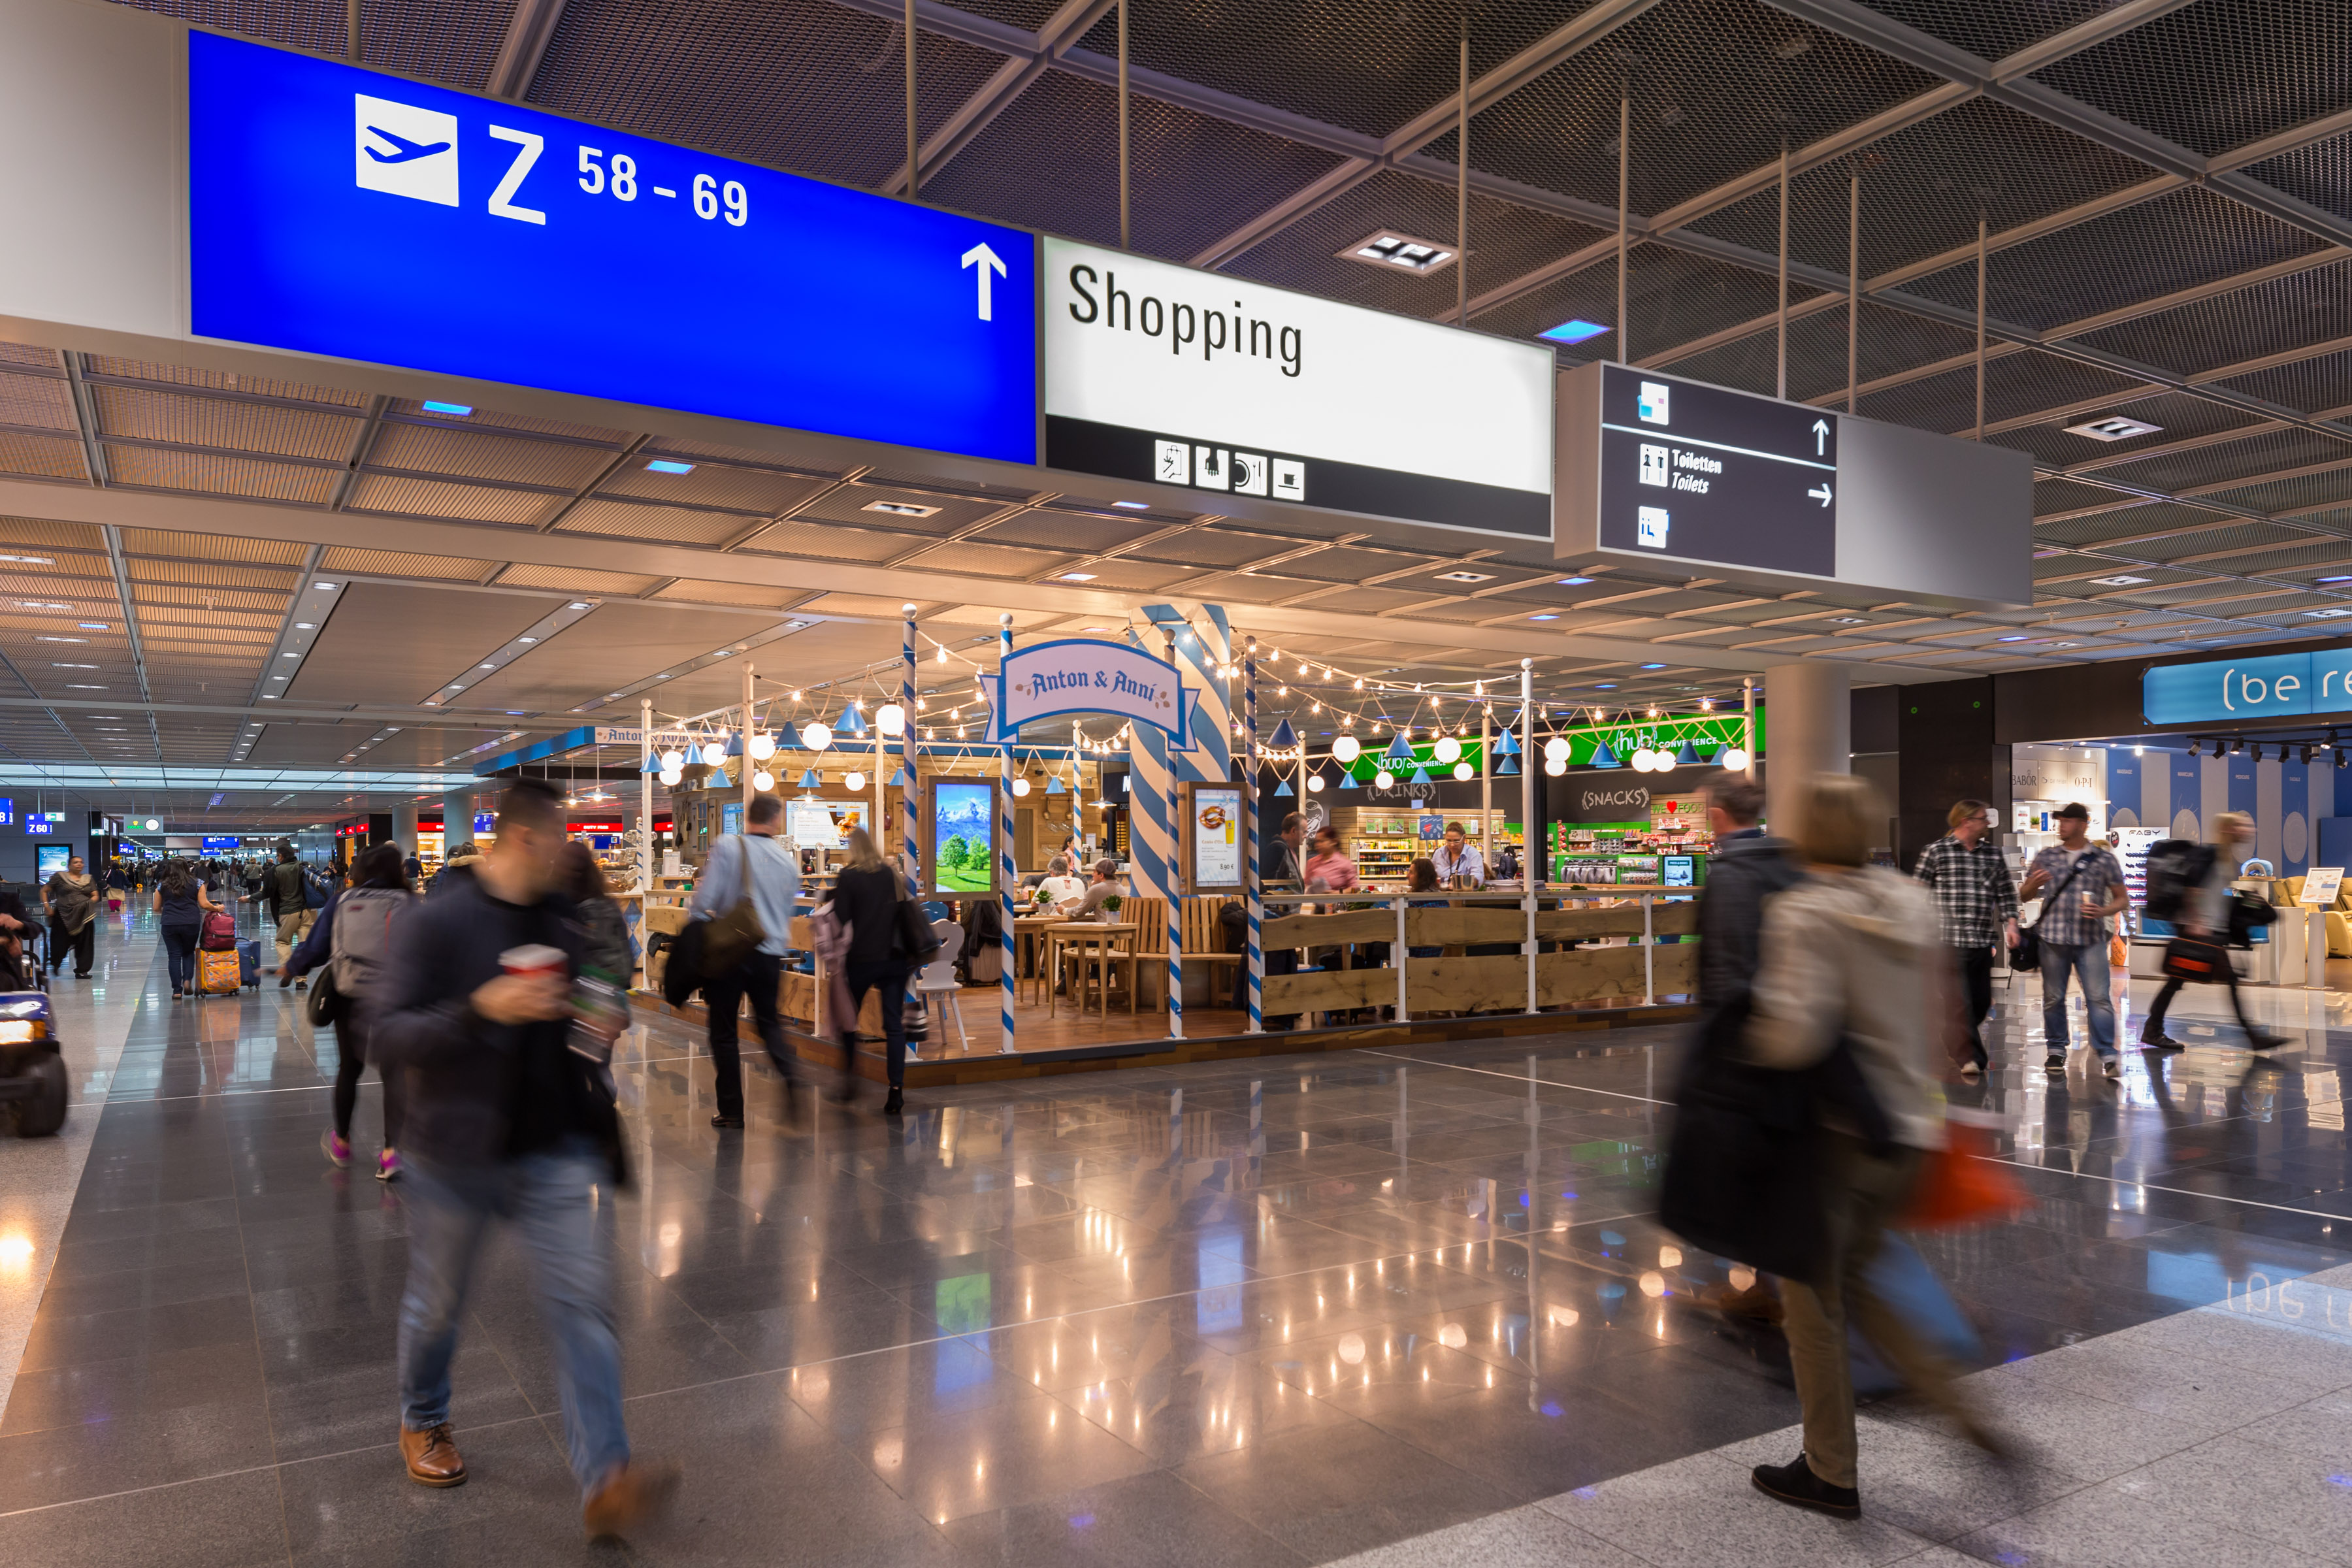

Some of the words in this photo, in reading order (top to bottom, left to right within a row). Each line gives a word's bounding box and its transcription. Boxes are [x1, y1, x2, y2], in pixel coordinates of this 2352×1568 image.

[487, 124, 546, 225] Z
[578, 145, 636, 201] 58
[692, 173, 749, 227] 69
[1069, 264, 1302, 378] Shopping
[1671, 449, 1722, 474] Toiletten
[1672, 472, 1709, 494] Toilets
[1032, 670, 1089, 700] Anton
[1094, 670, 1108, 688] &
[1109, 670, 1158, 702] Anni
[2012, 775, 2037, 786] BABOR
[1652, 804, 1667, 813] WE
[1678, 802, 1704, 813] FOOD
[29, 824, 35, 832] Z
[36, 824, 48, 833] 60
